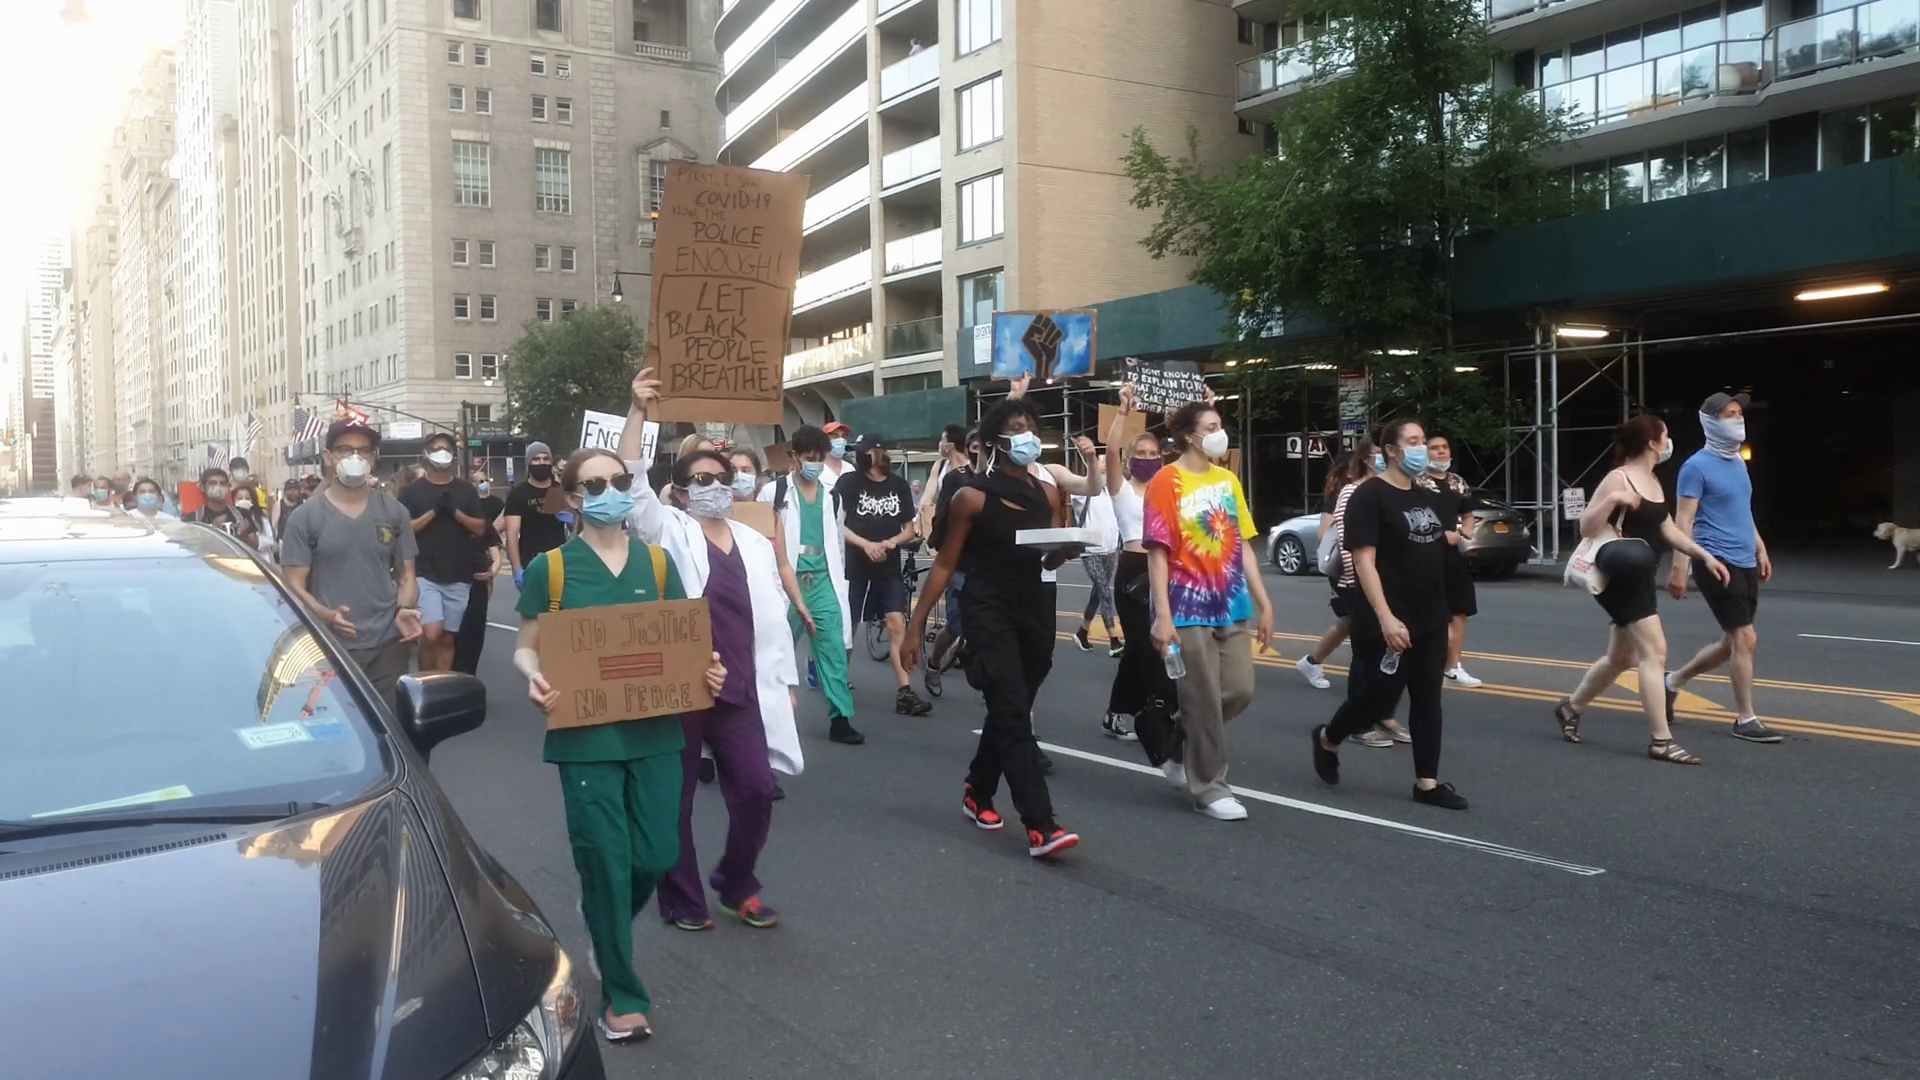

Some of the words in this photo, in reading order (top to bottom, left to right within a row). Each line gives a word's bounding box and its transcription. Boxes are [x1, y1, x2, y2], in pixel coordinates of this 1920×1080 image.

[695, 189, 772, 210] COVID-19
[705, 208, 727, 221] THE
[692, 221, 765, 245] POLICE
[675, 246, 783, 283] ENOUGH!
[696, 281, 755, 317] LET
[665, 311, 747, 340] BLACK
[683, 337, 768, 364] PEOPLE
[669, 363, 781, 393] BREATHE!
[1127, 371, 1139, 381] TO
[1141, 375, 1178, 389] EXPLAIN
[1180, 380, 1193, 390] TO
[1163, 371, 1190, 379] KNOW
[1143, 393, 1163, 405] CARE
[1152, 386, 1167, 396] YOU
[1168, 390, 1203, 402] SHOULD
[570, 618, 606, 652] NO
[574, 688, 608, 720] NO
[624, 682, 693, 713] PEACE
